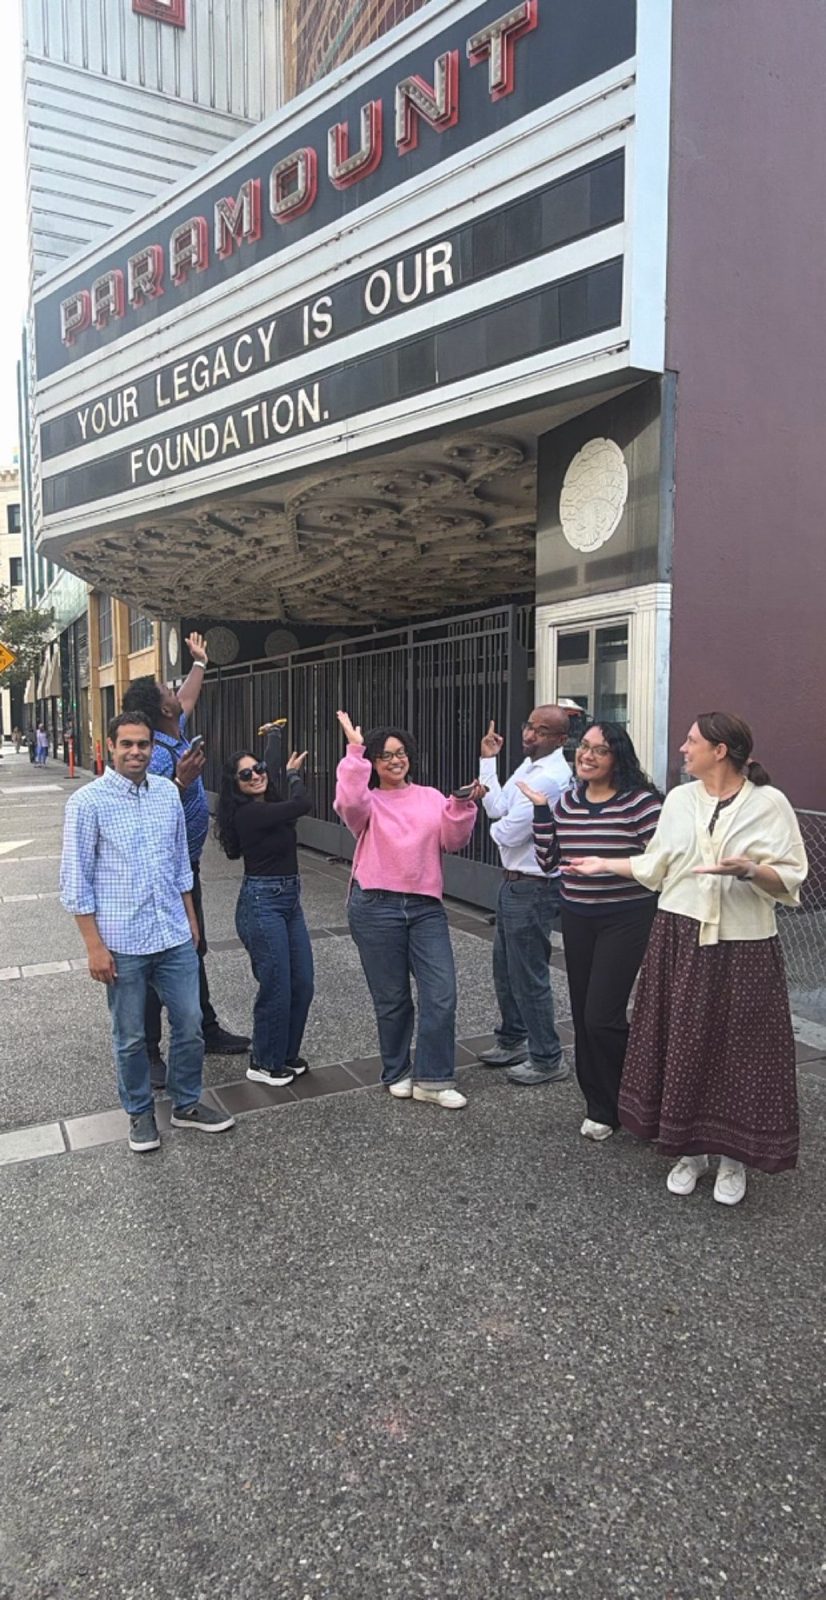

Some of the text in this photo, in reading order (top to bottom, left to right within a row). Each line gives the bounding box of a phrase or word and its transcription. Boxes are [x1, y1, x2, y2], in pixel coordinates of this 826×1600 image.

[60, 0, 538, 347] PARAMOUNT
[77, 241, 454, 440] YOUR LEGACY IS OUR
[130, 382, 330, 483] FOUNDATION.
